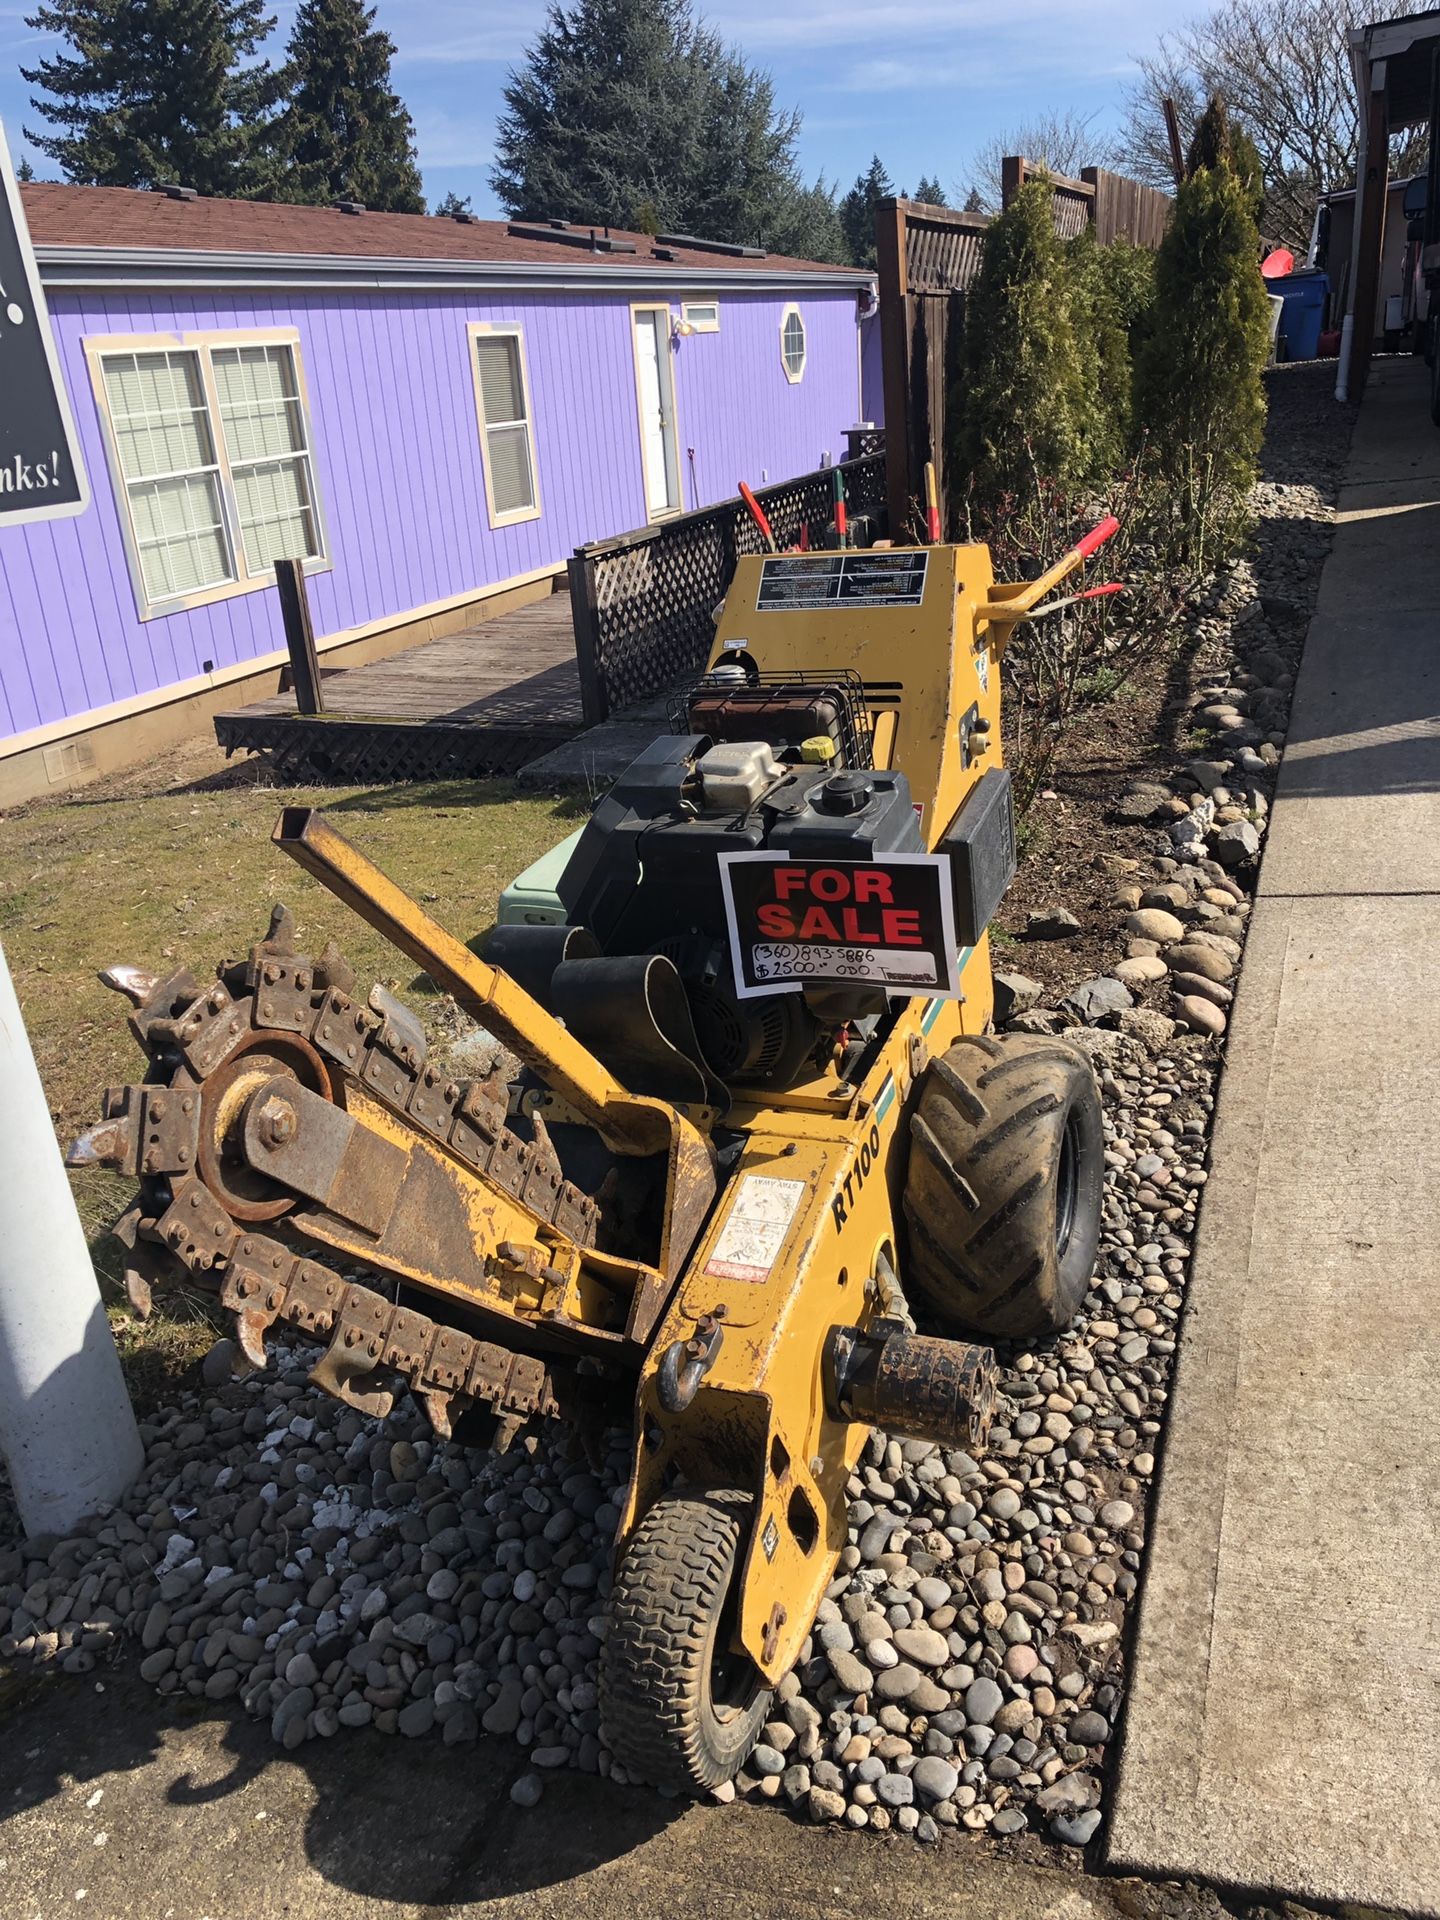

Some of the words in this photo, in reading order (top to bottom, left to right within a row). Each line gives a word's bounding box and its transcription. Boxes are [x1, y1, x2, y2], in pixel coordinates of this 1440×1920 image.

[773, 868, 894, 904] FOR
[757, 904, 923, 945] SALE
[831, 1124, 880, 1236] RT100
